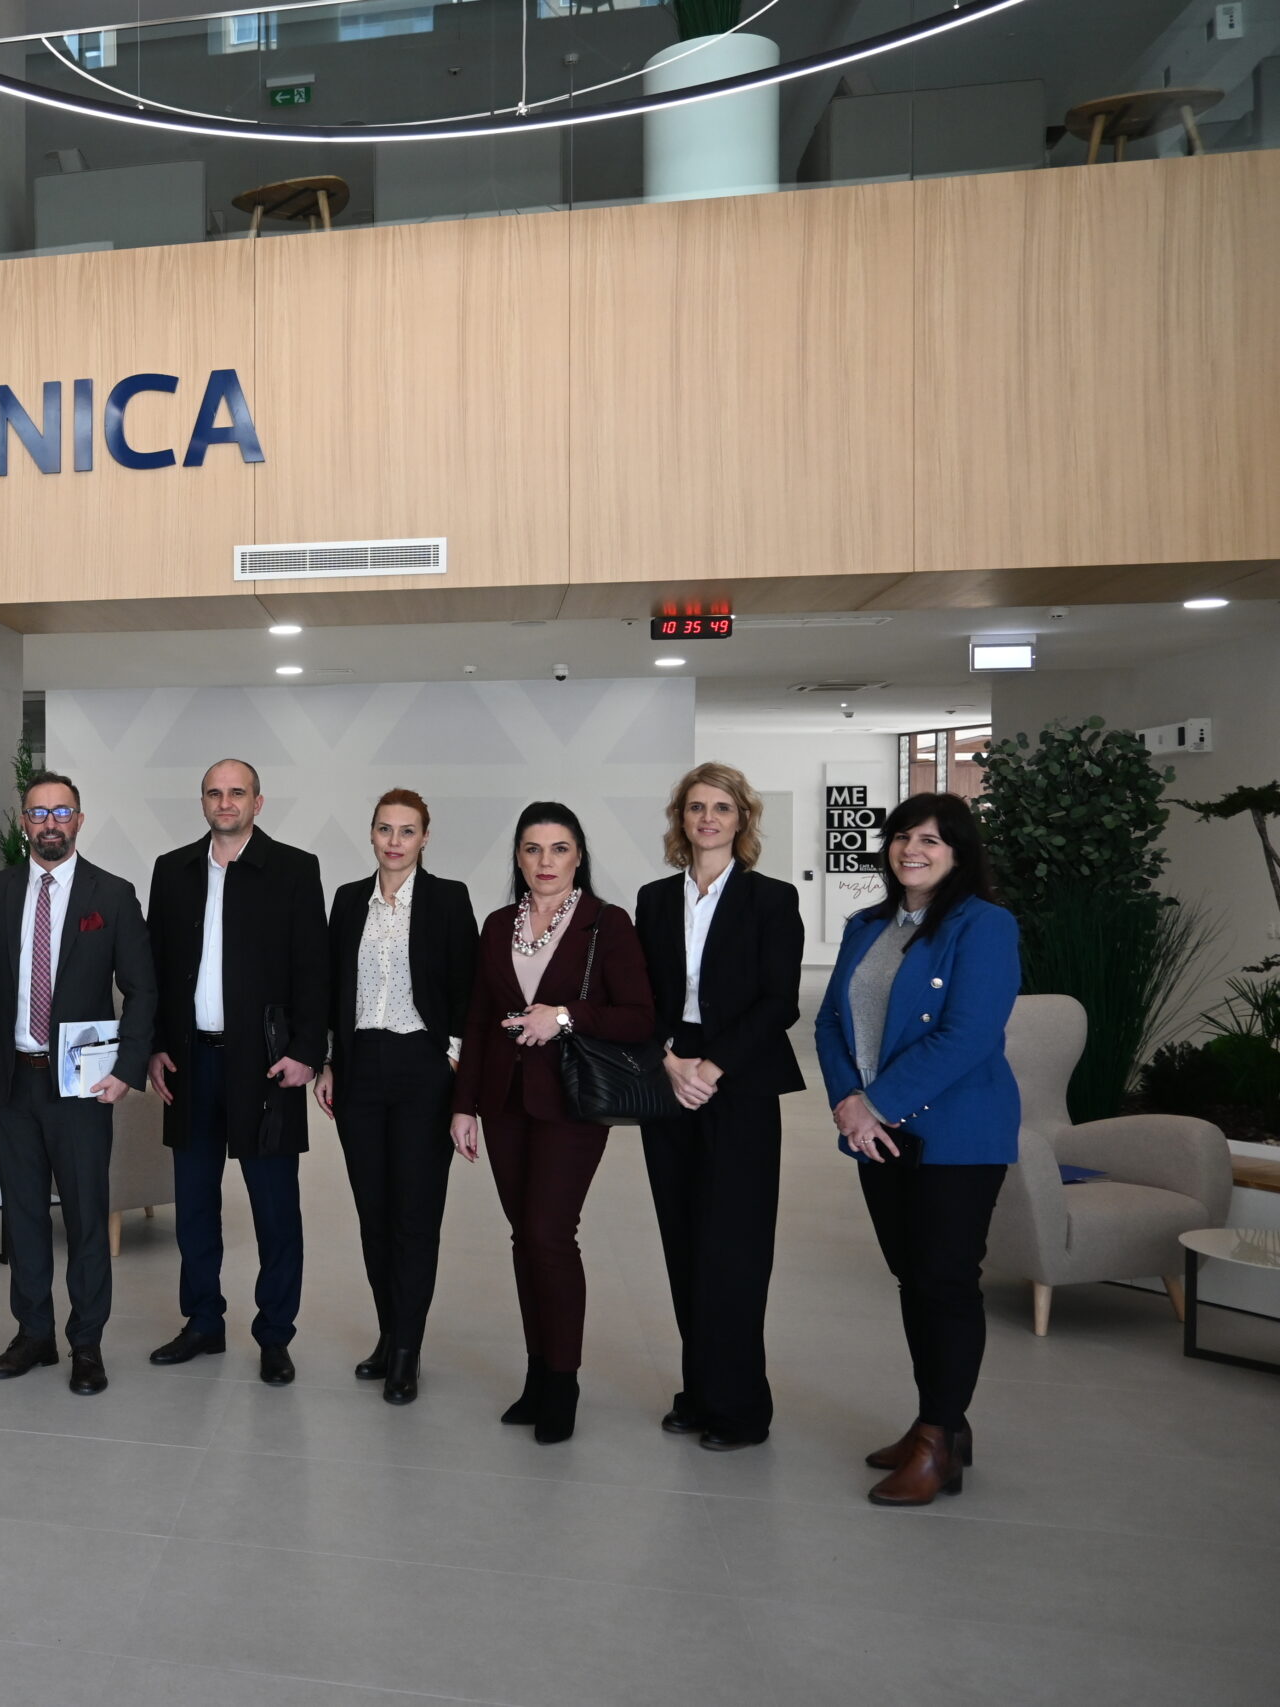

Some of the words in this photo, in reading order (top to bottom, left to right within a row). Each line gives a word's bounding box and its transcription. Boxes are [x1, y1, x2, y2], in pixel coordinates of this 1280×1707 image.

[662, 621, 677, 634] 10
[683, 620, 702, 633] 35
[710, 620, 729, 633] 49
[829, 787, 865, 806] ME
[829, 809, 876, 828] TRO
[829, 831, 862, 850] PO
[829, 854, 859, 872] LIS
[838, 874, 884, 899] vizita
